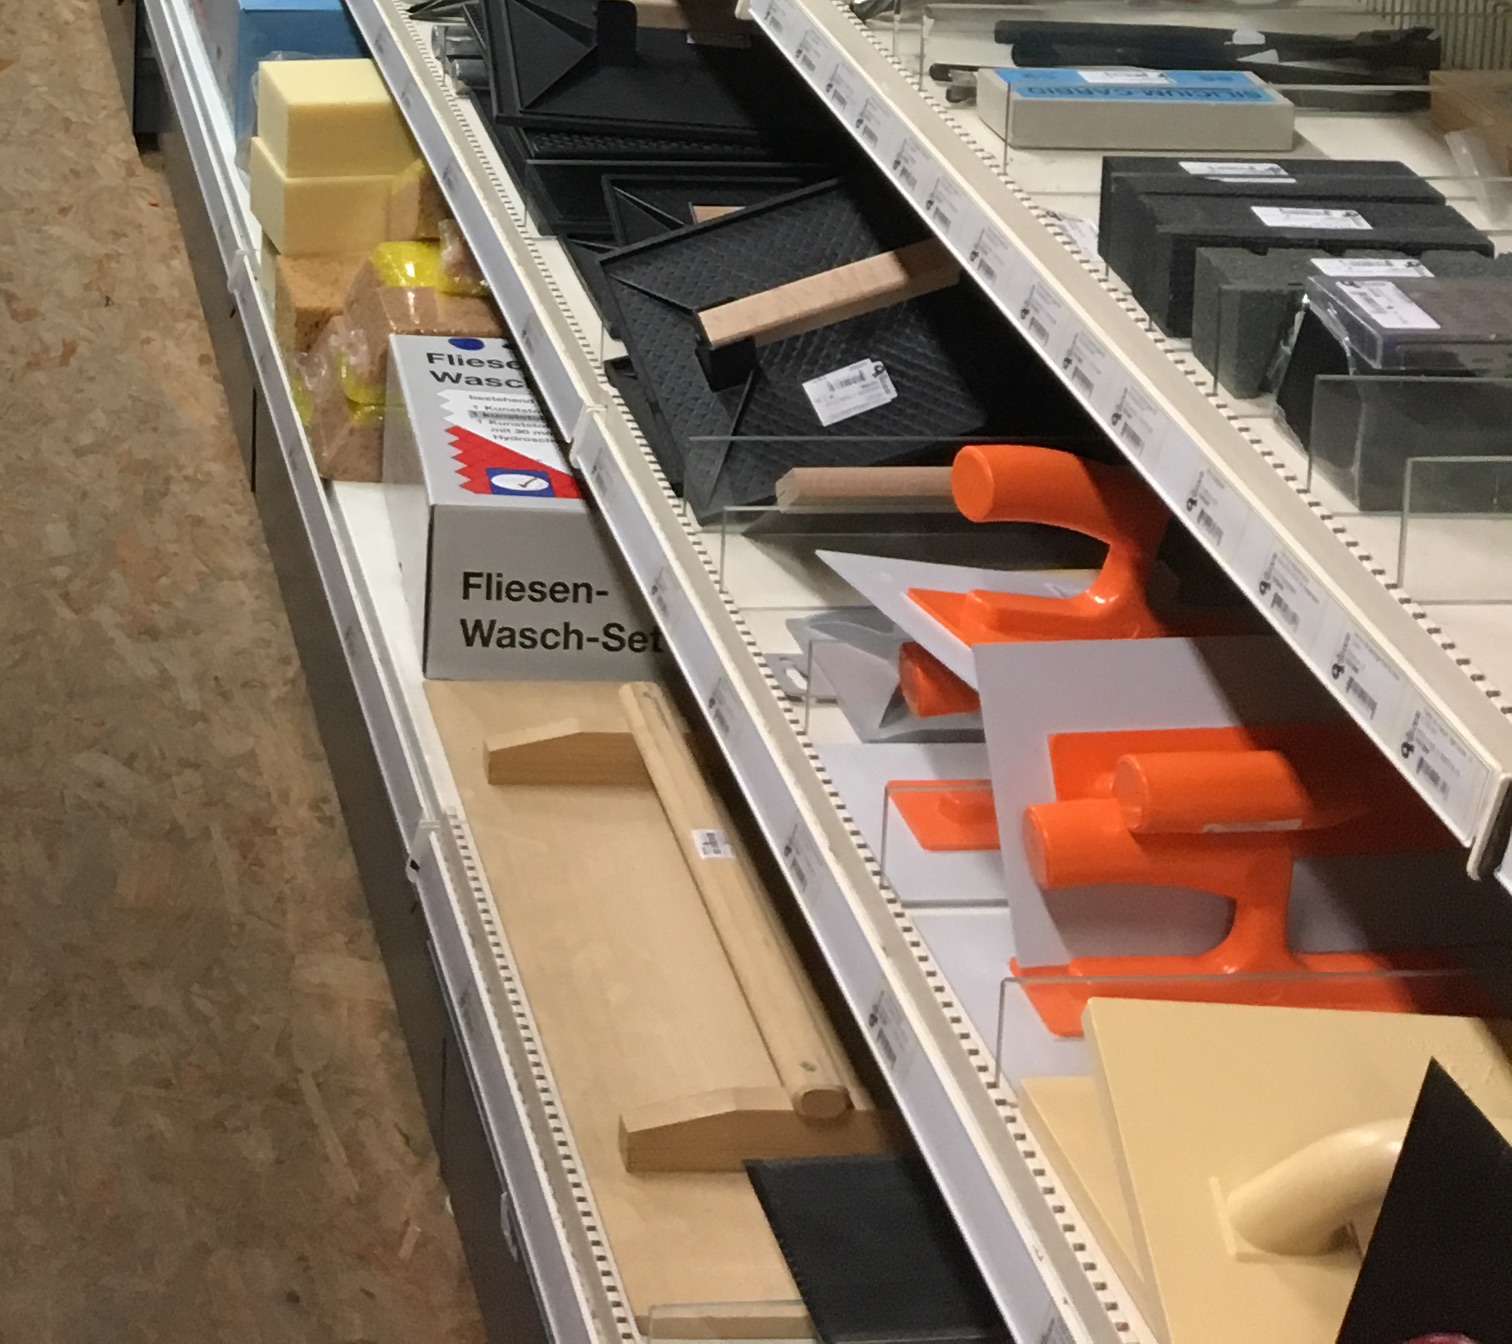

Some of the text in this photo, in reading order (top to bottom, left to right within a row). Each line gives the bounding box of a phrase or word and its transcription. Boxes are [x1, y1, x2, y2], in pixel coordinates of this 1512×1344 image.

[426, 352, 521, 370] Fliese
[429, 370, 525, 389] Wasc
[484, 405, 540, 414] Kunststo
[461, 572, 608, 604] Fliesen-
[460, 619, 664, 653] Wasch-Set
